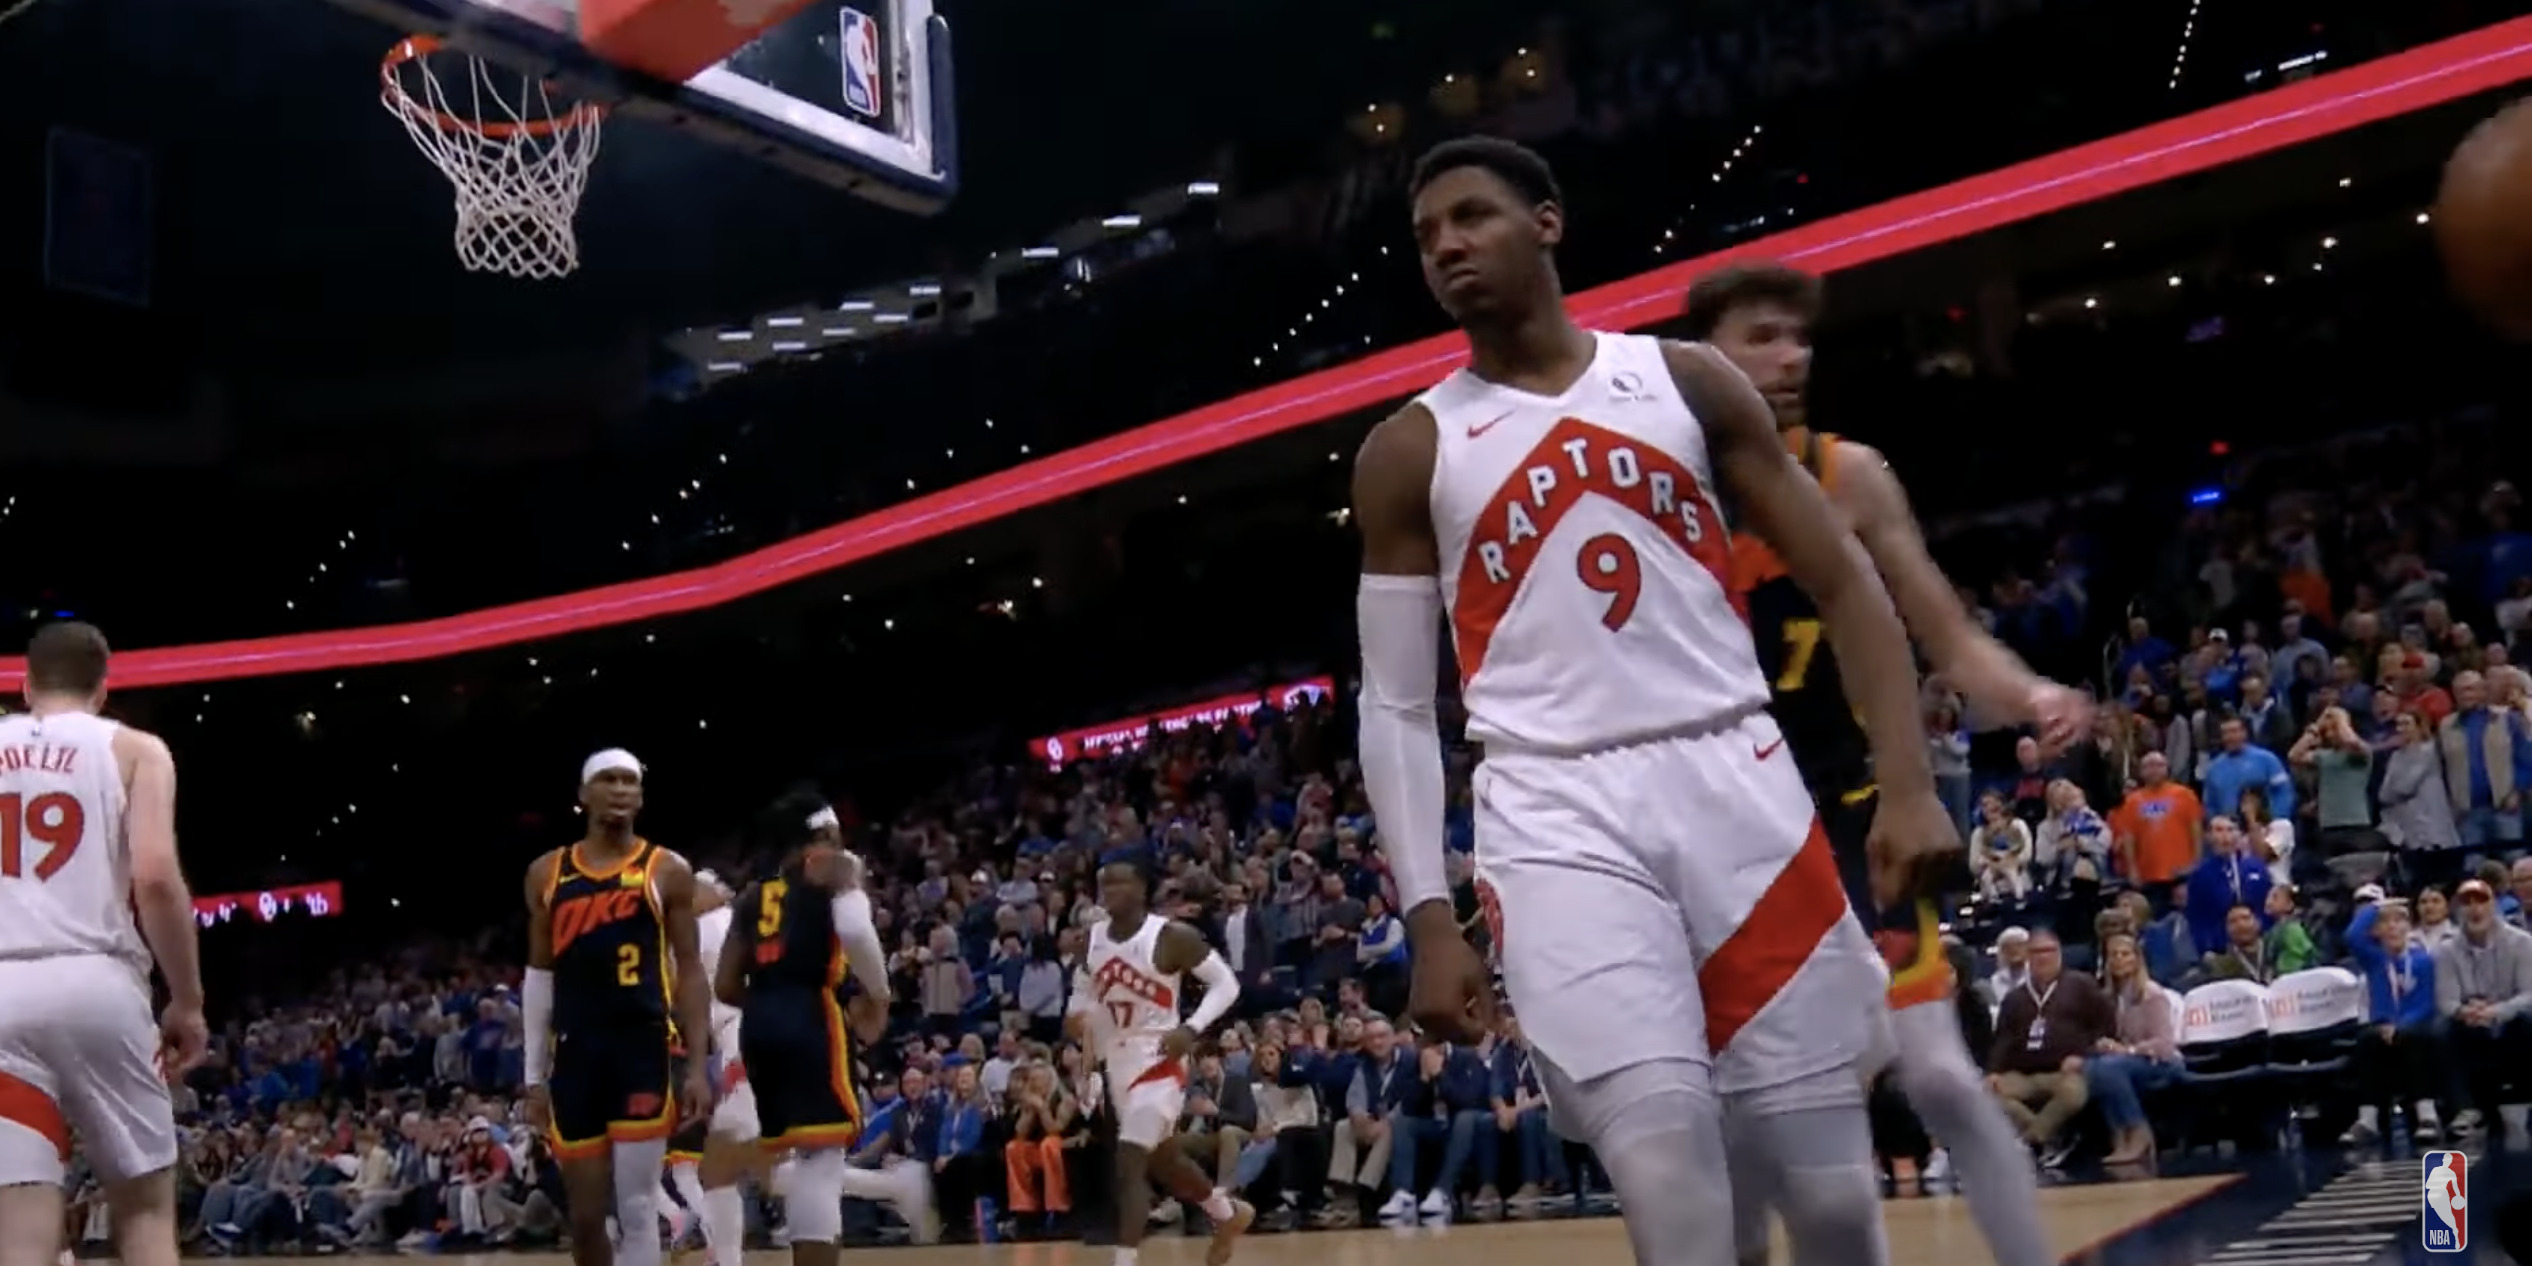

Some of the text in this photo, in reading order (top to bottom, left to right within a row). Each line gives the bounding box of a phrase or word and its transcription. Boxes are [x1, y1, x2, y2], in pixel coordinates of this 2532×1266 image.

[1478, 438, 1702, 585] RAPTORS
[1576, 532, 1642, 633] 9
[1776, 620, 1820, 690] 7
[0, 742, 78, 776] OELTL
[0, 791, 85, 883] 19
[552, 889, 642, 956] OKC
[758, 879, 788, 937] 5
[617, 942, 641, 987] 2
[1105, 1001, 1134, 1029] 17
